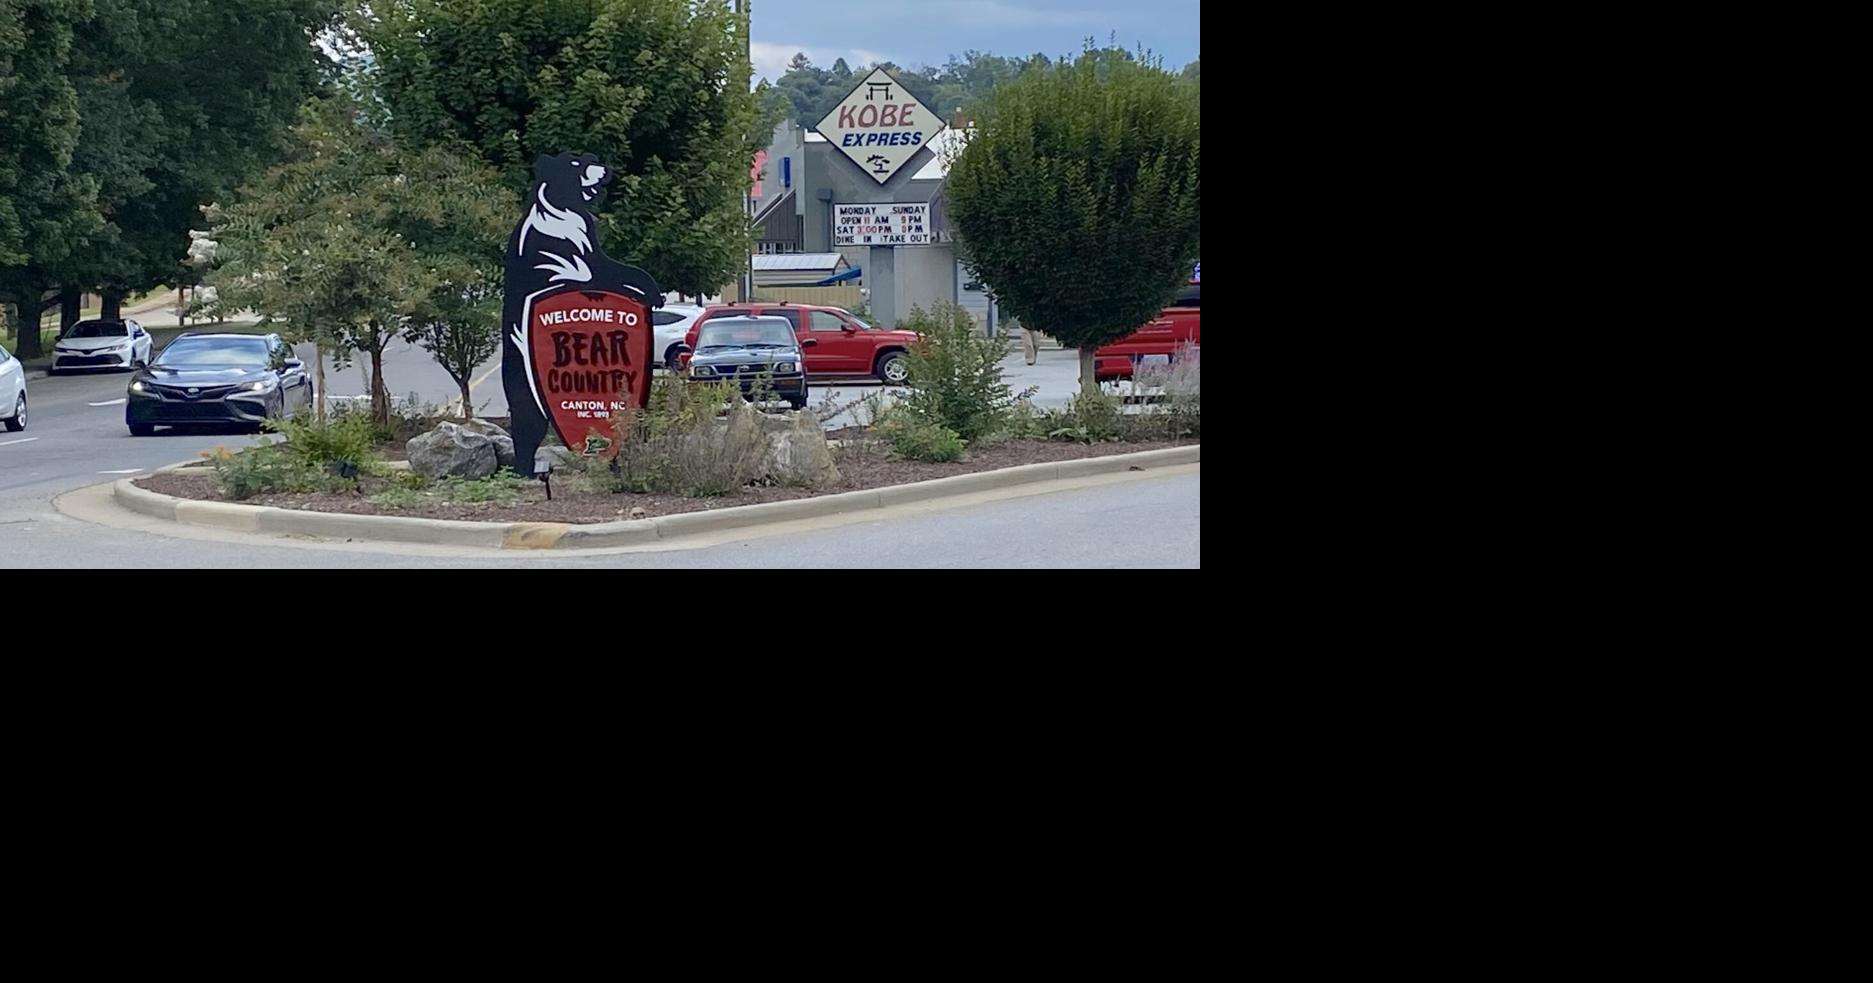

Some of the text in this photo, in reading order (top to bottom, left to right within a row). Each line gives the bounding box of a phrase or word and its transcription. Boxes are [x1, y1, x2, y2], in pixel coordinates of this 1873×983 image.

[838, 103, 917, 129] KOBE
[842, 131, 923, 147] EXPRESS
[840, 206, 926, 215] MONDAY SUNDAY
[840, 216, 862, 225] OPEN
[874, 216, 889, 224] AM
[908, 215, 922, 223] PM
[836, 226, 855, 234] SAT
[836, 234, 928, 244] DINE IN TAKE OUT
[539, 308, 638, 327] WELCOME TO
[551, 330, 632, 368] BEAR
[548, 368, 638, 394] COUNTRY
[561, 400, 626, 411] CANTON, NC
